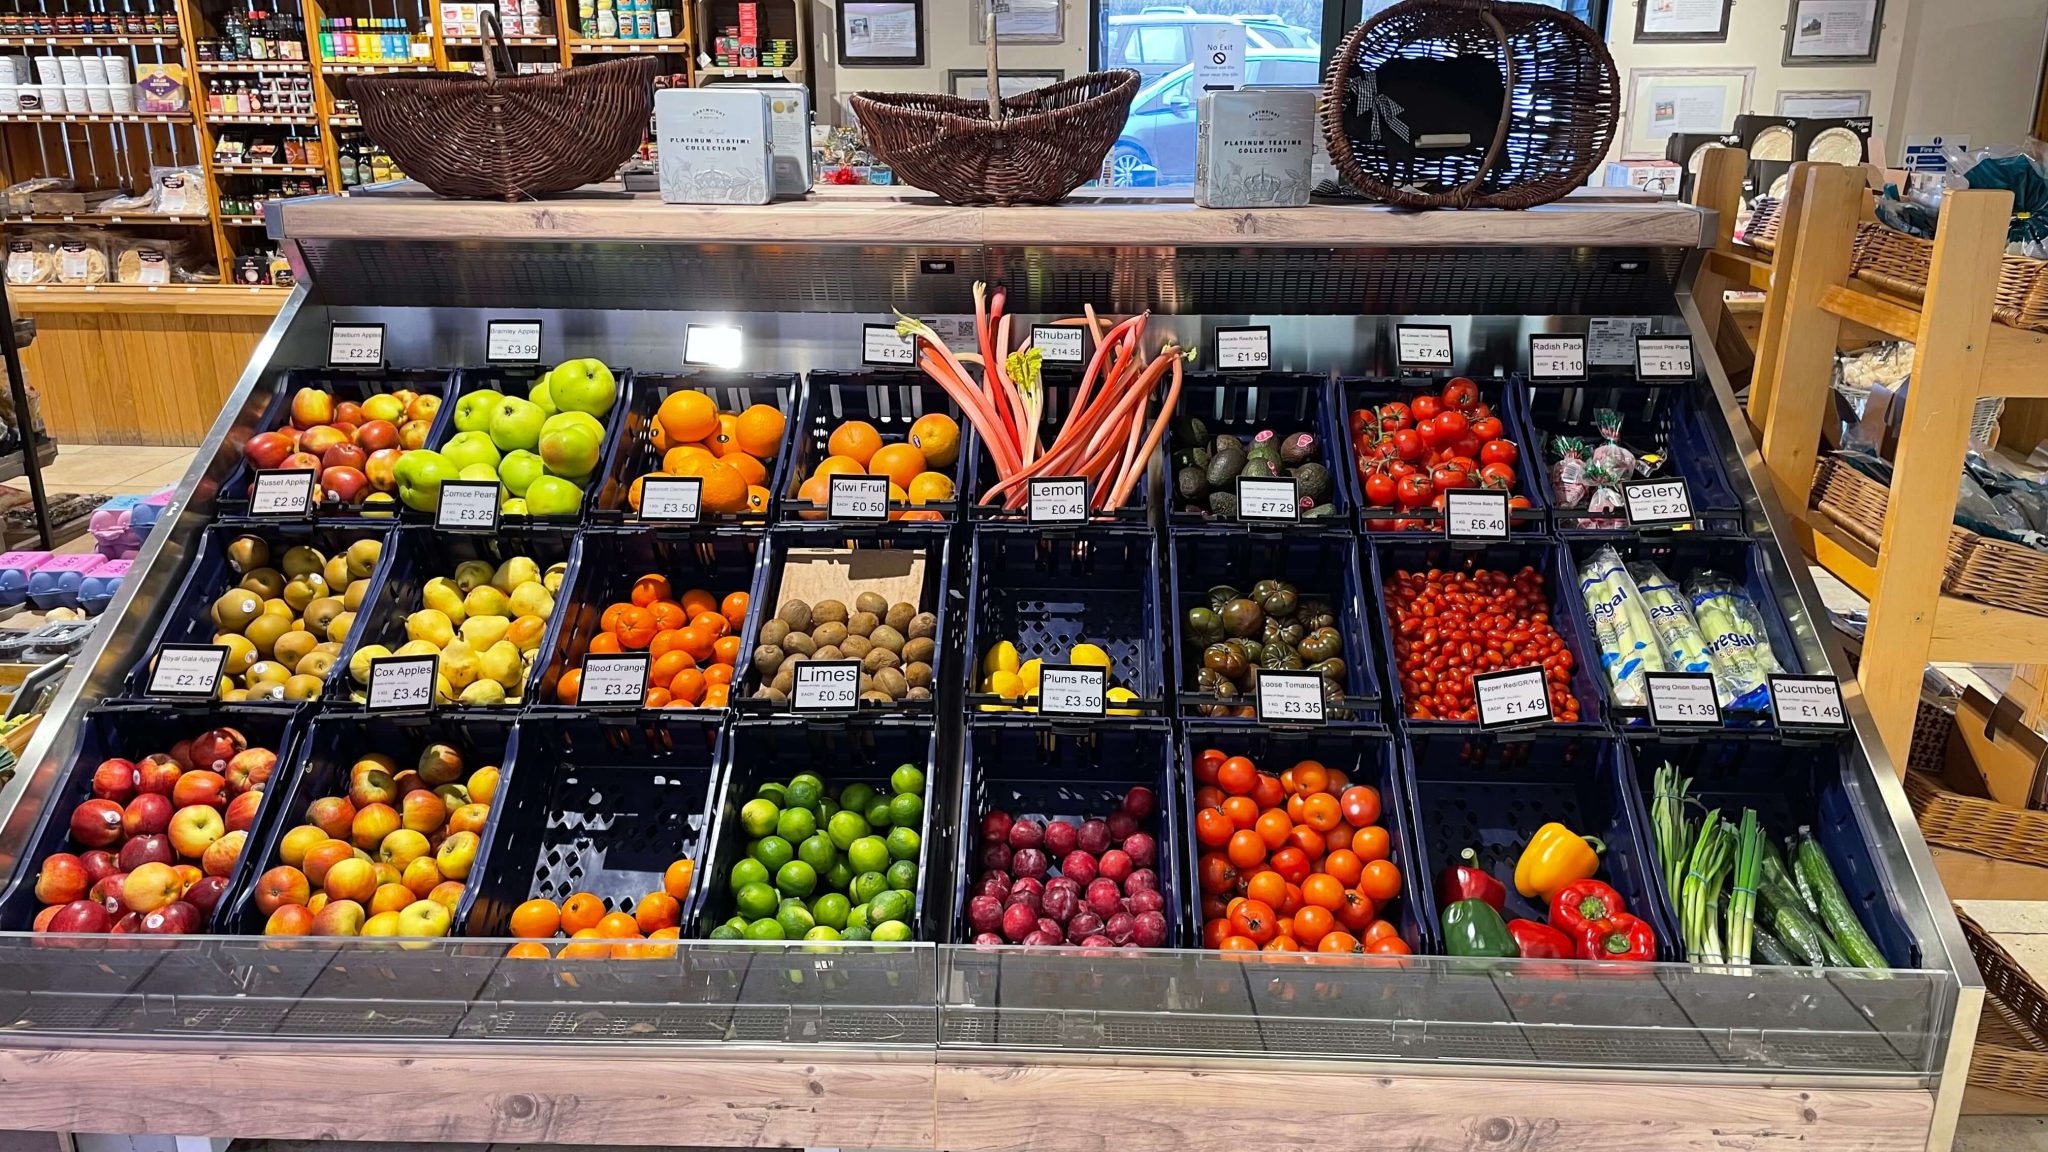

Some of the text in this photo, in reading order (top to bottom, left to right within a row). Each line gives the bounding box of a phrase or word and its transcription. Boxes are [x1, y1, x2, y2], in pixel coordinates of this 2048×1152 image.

[1248, 110, 1280, 119] CARTWRIGHT
[1034, 330, 1081, 340] Rhubarb
[508, 345, 537, 354] £3.99
[1534, 342, 1582, 350] Radish Pack
[350, 349, 380, 358] £2.25
[884, 349, 912, 358] £1.25
[1238, 352, 1267, 362] £1.99
[1420, 349, 1449, 358] £7.40
[1552, 361, 1582, 370] £1.10
[1660, 361, 1691, 371] £1.19
[286, 479, 309, 487] Apples
[834, 482, 886, 493] Kiwi Fruit
[1032, 484, 1083, 496] Lemon
[1628, 486, 1683, 500] Celery
[274, 497, 305, 507] £2.99
[852, 502, 884, 511] £0.50
[1261, 502, 1293, 512] £7.29
[663, 504, 695, 513] £3.50
[1052, 505, 1084, 514] £0.45
[1653, 504, 1687, 514] £2.20
[460, 510, 493, 520] £3.25
[1471, 520, 1504, 530] £6.40
[161, 655, 180, 663] Royal
[199, 656, 221, 664] Apples
[375, 666, 431, 678] Cox Apples
[586, 663, 645, 673] Blood Orange
[799, 667, 856, 682] Limes
[1044, 674, 1102, 684] Plums Red
[176, 675, 213, 686] £2.15
[1285, 681, 1320, 689] Tomatoes
[393, 687, 428, 699] £3.45
[604, 684, 641, 695] £3.25
[1480, 684, 1501, 693] Pepper
[1774, 683, 1836, 695] Cucumber
[819, 690, 854, 701] £0.50
[1065, 696, 1101, 707] £3.50
[1506, 698, 1545, 714] £1.49
[1284, 702, 1320, 713] £3.35
[1678, 704, 1715, 716] £1.39
[1802, 706, 1840, 718] £1.49
